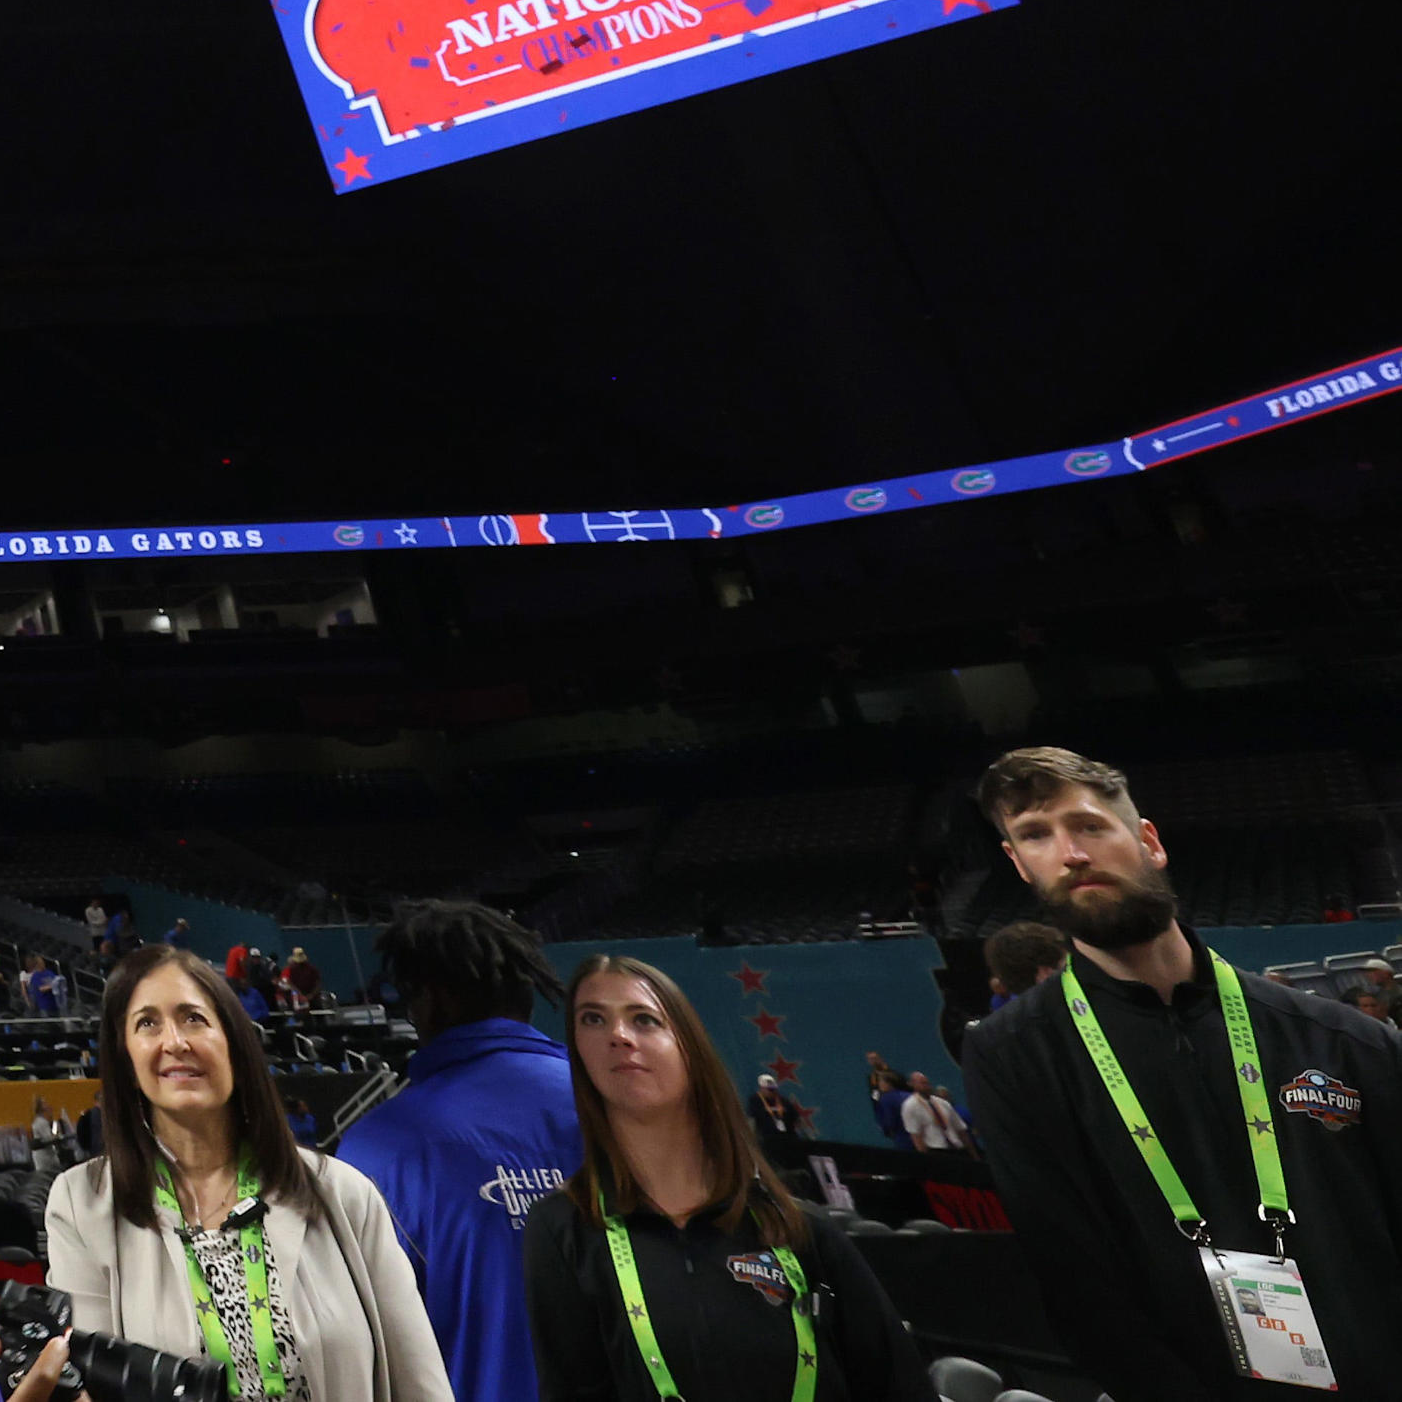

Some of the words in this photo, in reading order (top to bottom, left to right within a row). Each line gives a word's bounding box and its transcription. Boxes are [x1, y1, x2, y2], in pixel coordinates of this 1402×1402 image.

[1264, 371, 1378, 418] FLORIDA
[131, 530, 264, 553] GATORS
[1285, 1088, 1328, 1105] FINAL
[1327, 1092, 1362, 1111] FOUR
[496, 1164, 565, 1191] ALLIED
[733, 1261, 772, 1280] FINAL
